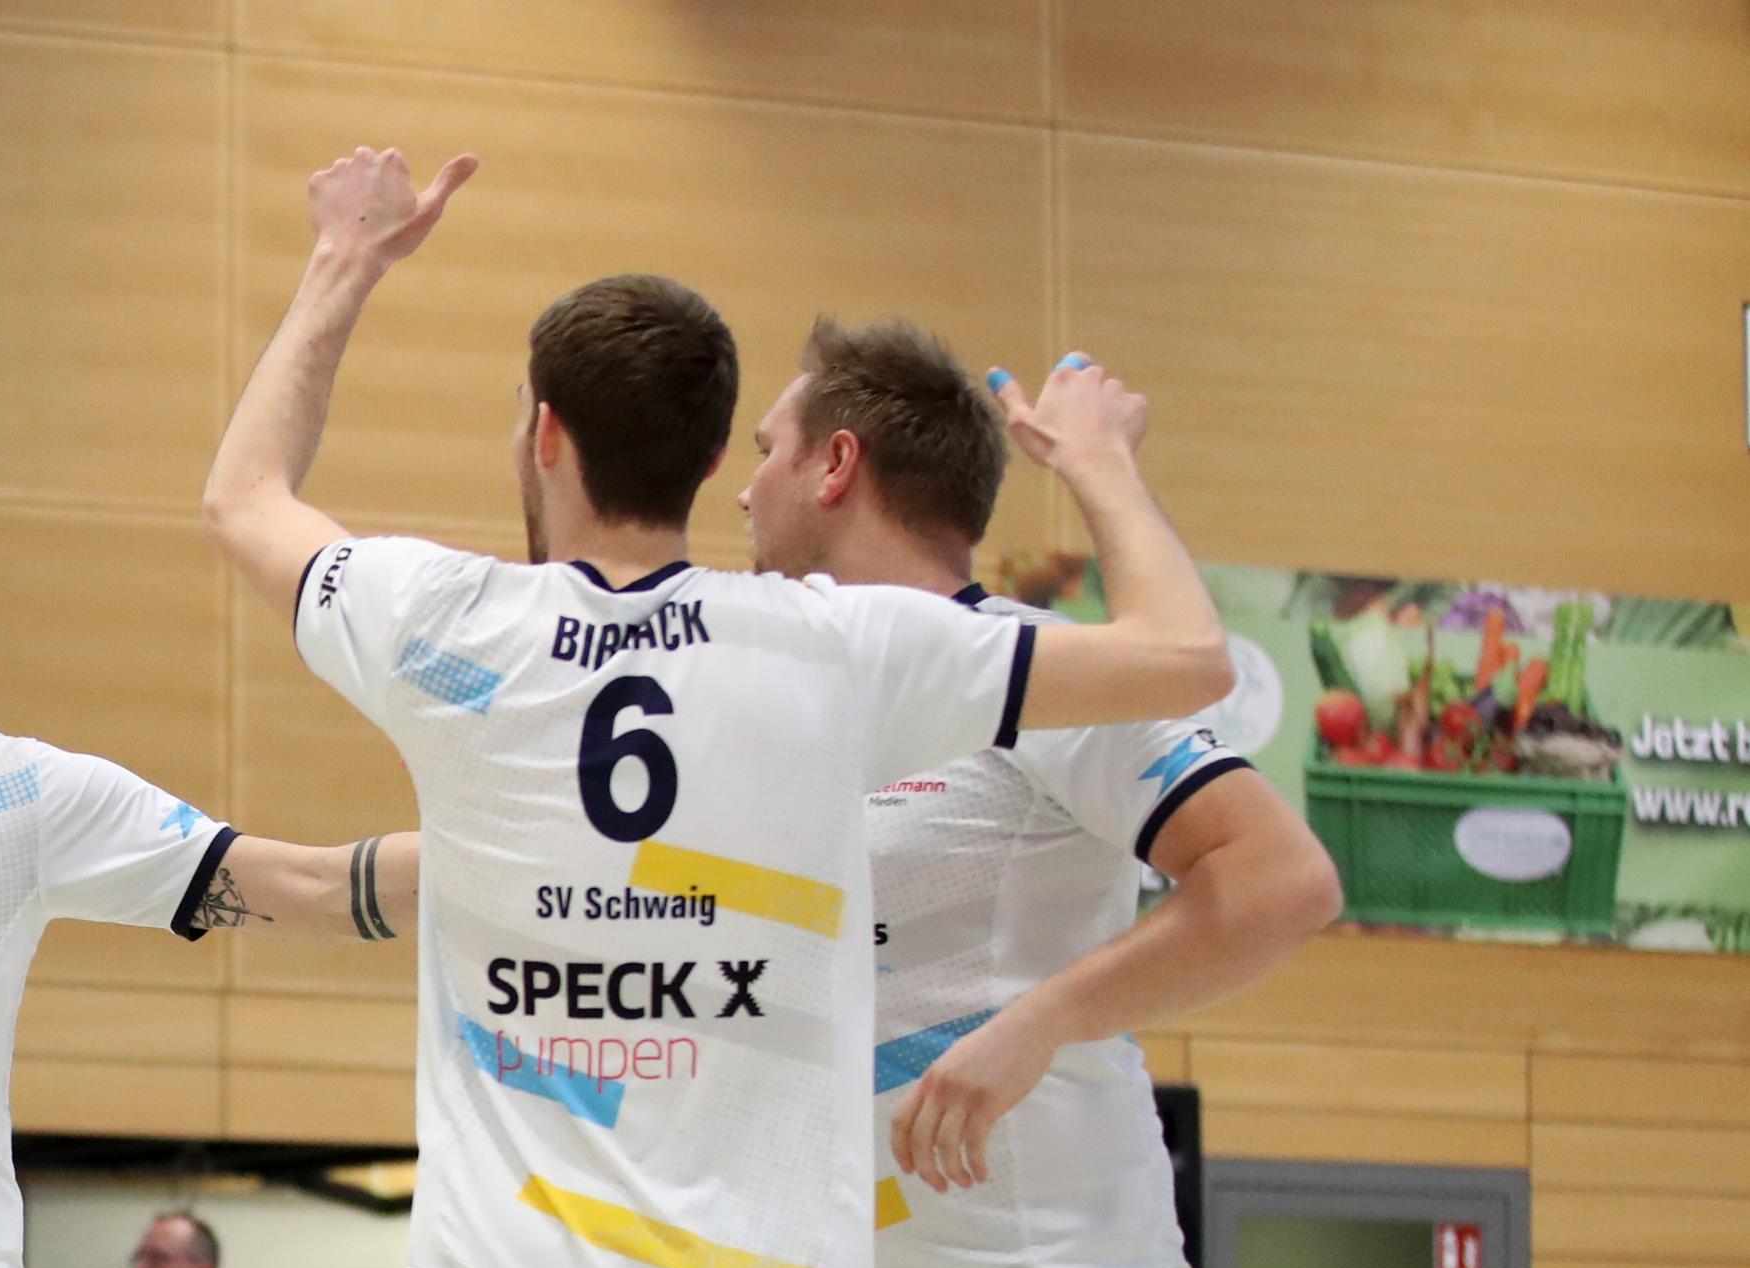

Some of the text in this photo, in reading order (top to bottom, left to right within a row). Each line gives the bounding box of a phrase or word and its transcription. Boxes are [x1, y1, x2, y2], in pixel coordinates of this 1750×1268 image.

[578, 676, 678, 843] 6
[1630, 712, 1729, 763] Jetzt
[536, 886, 716, 926] SV Schwaig
[487, 957, 696, 1019] SPECK
